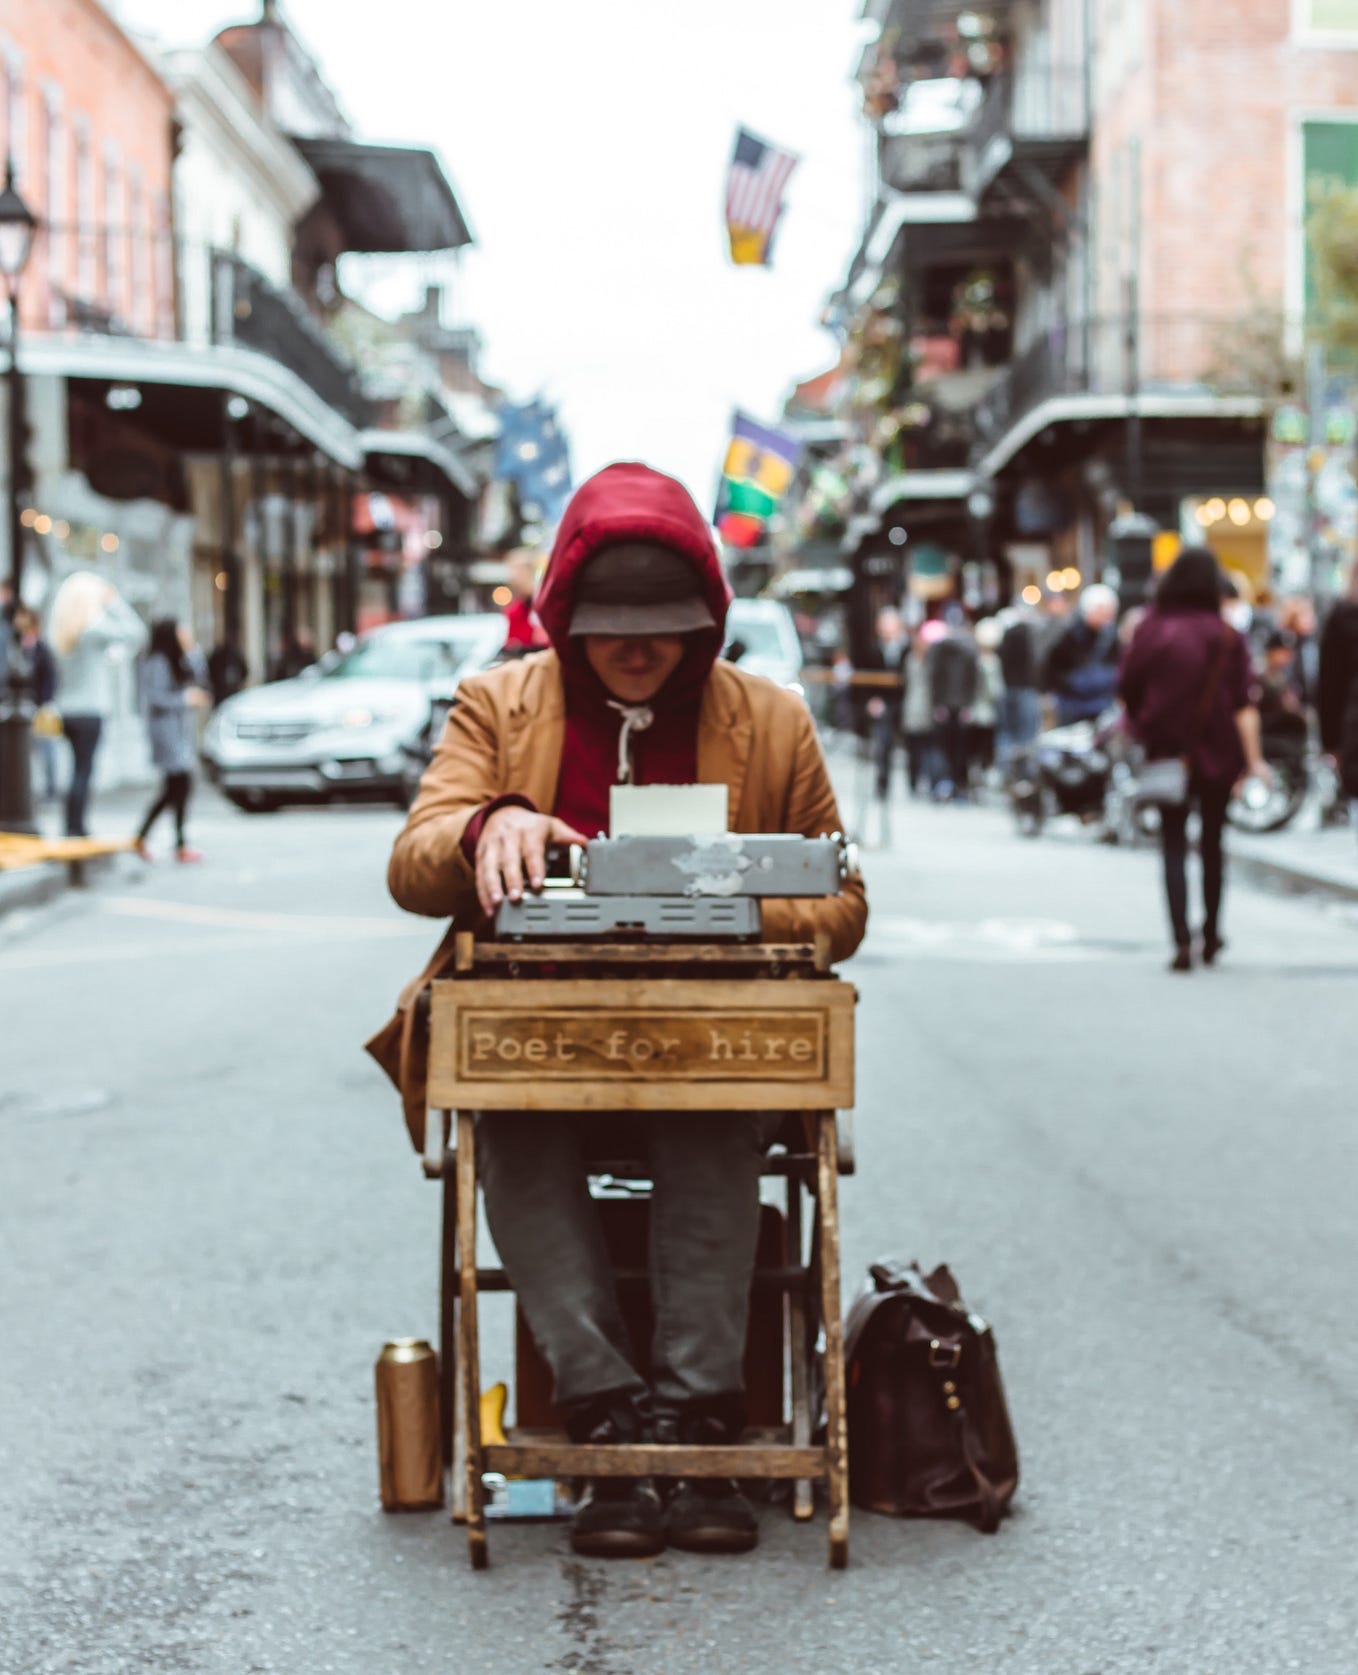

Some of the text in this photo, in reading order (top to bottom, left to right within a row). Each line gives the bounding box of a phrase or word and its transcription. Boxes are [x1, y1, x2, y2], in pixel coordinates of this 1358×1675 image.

[472, 1030, 814, 1061] Poet for hire
